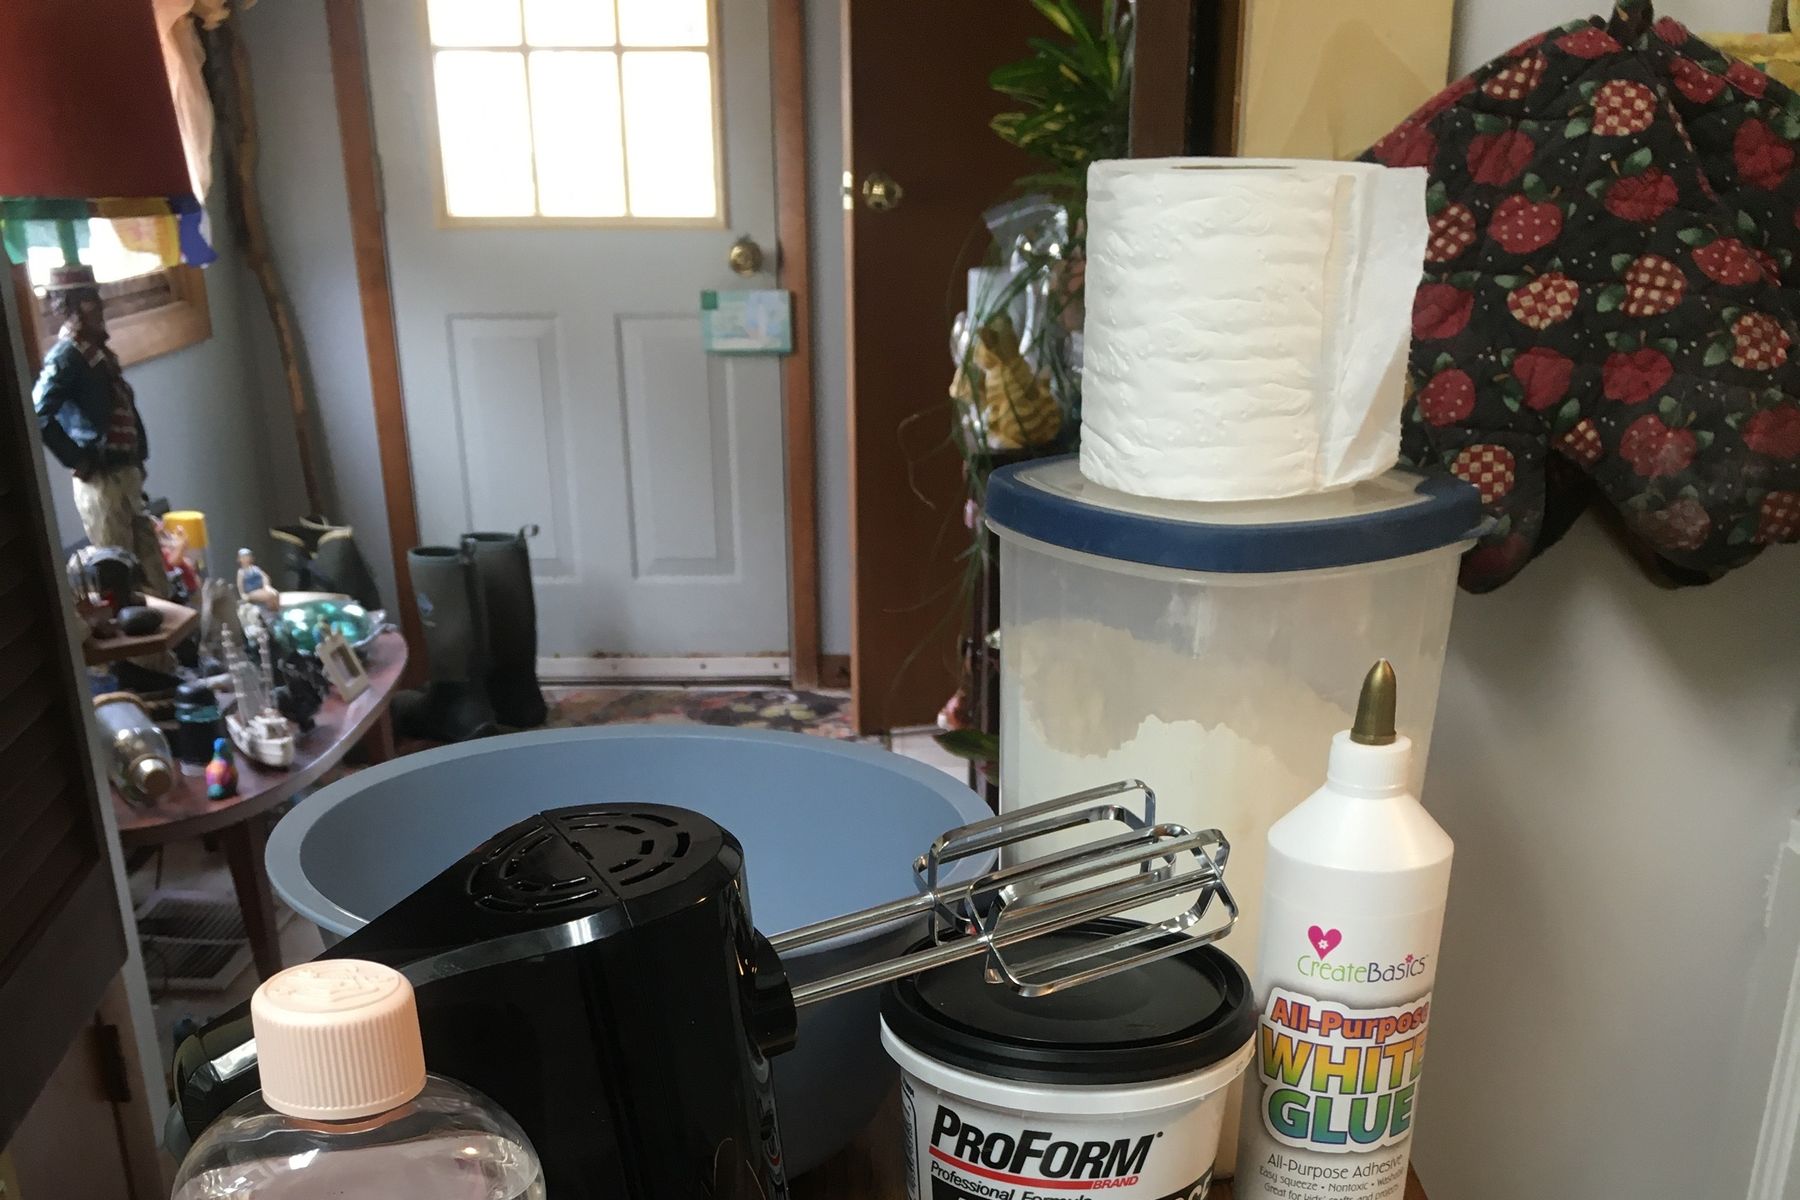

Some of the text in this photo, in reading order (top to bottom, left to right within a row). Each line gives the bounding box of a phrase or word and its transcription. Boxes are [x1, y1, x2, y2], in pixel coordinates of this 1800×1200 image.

[1297, 954, 1427, 983] CreateBasics
[1268, 1083, 1415, 1145] GLUE
[1267, 1153, 1349, 1180] All-Purpose
[1092, 1175, 1139, 1190] BRAND
[1264, 1182, 1287, 1197] Great
[1288, 1190, 1302, 1200] for
[1280, 1176, 1318, 1191] squeeze
[1328, 1183, 1369, 1192] Nontoxic
